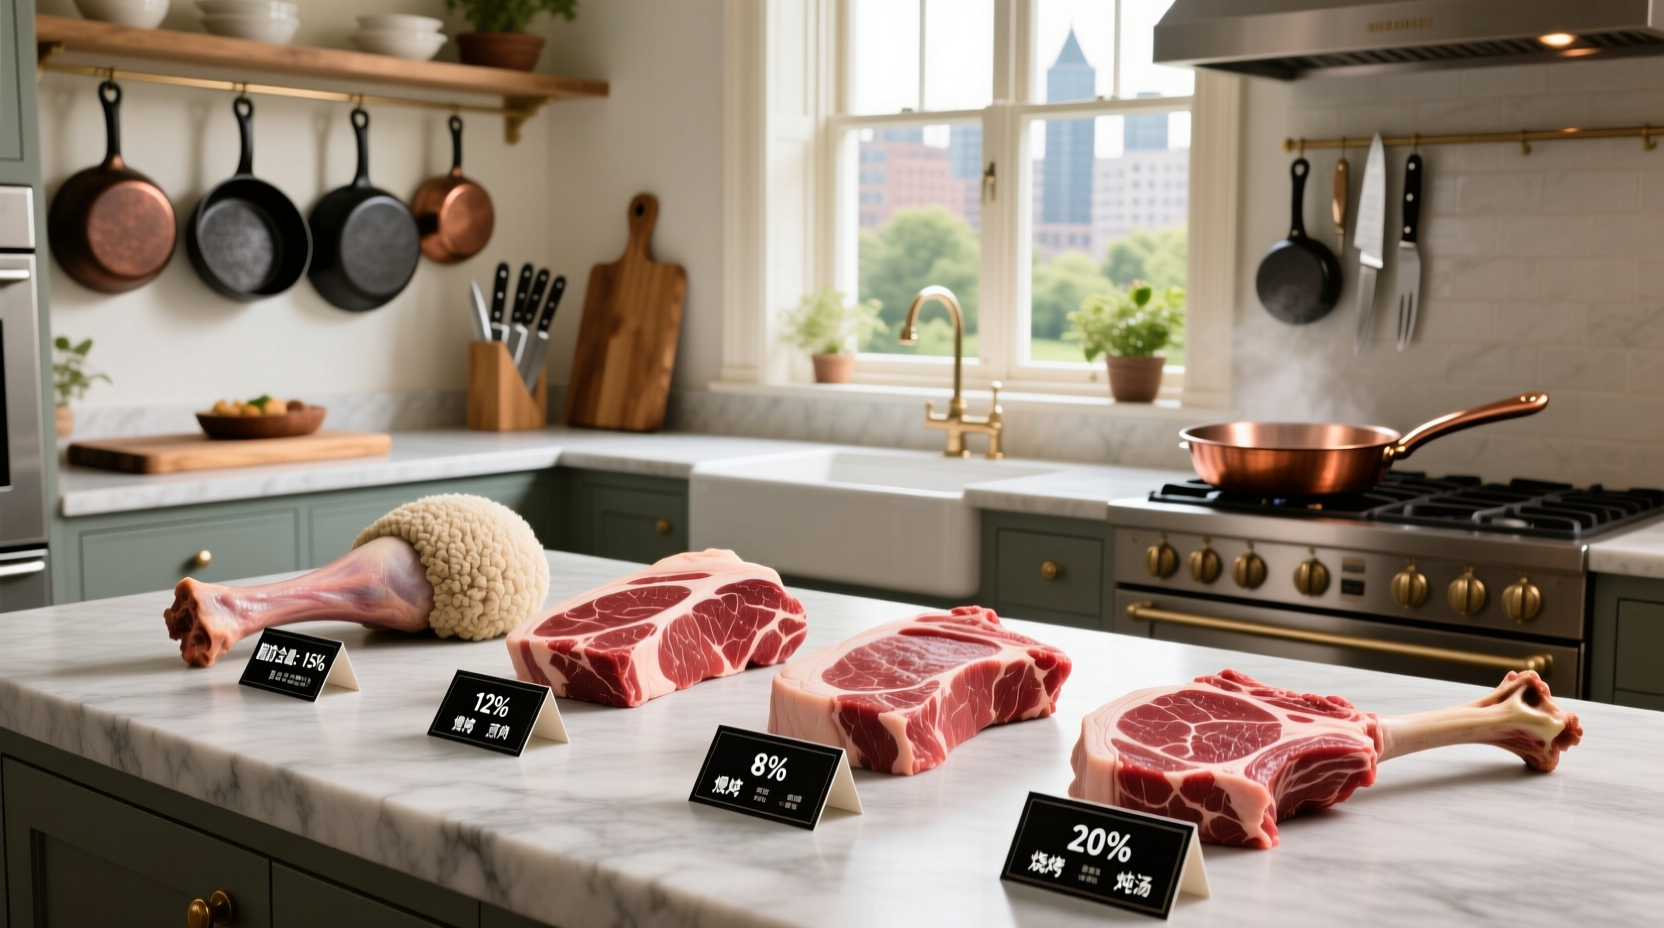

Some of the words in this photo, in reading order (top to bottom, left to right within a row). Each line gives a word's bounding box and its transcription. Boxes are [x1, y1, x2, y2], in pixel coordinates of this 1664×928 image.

[302, 652, 326, 671] 15%
[474, 692, 511, 717] 12%
[750, 752, 788, 782] 8%
[1067, 824, 1132, 863] 20%
[1027, 850, 1066, 878] 烧烤
[1113, 870, 1153, 898] 炖汤
